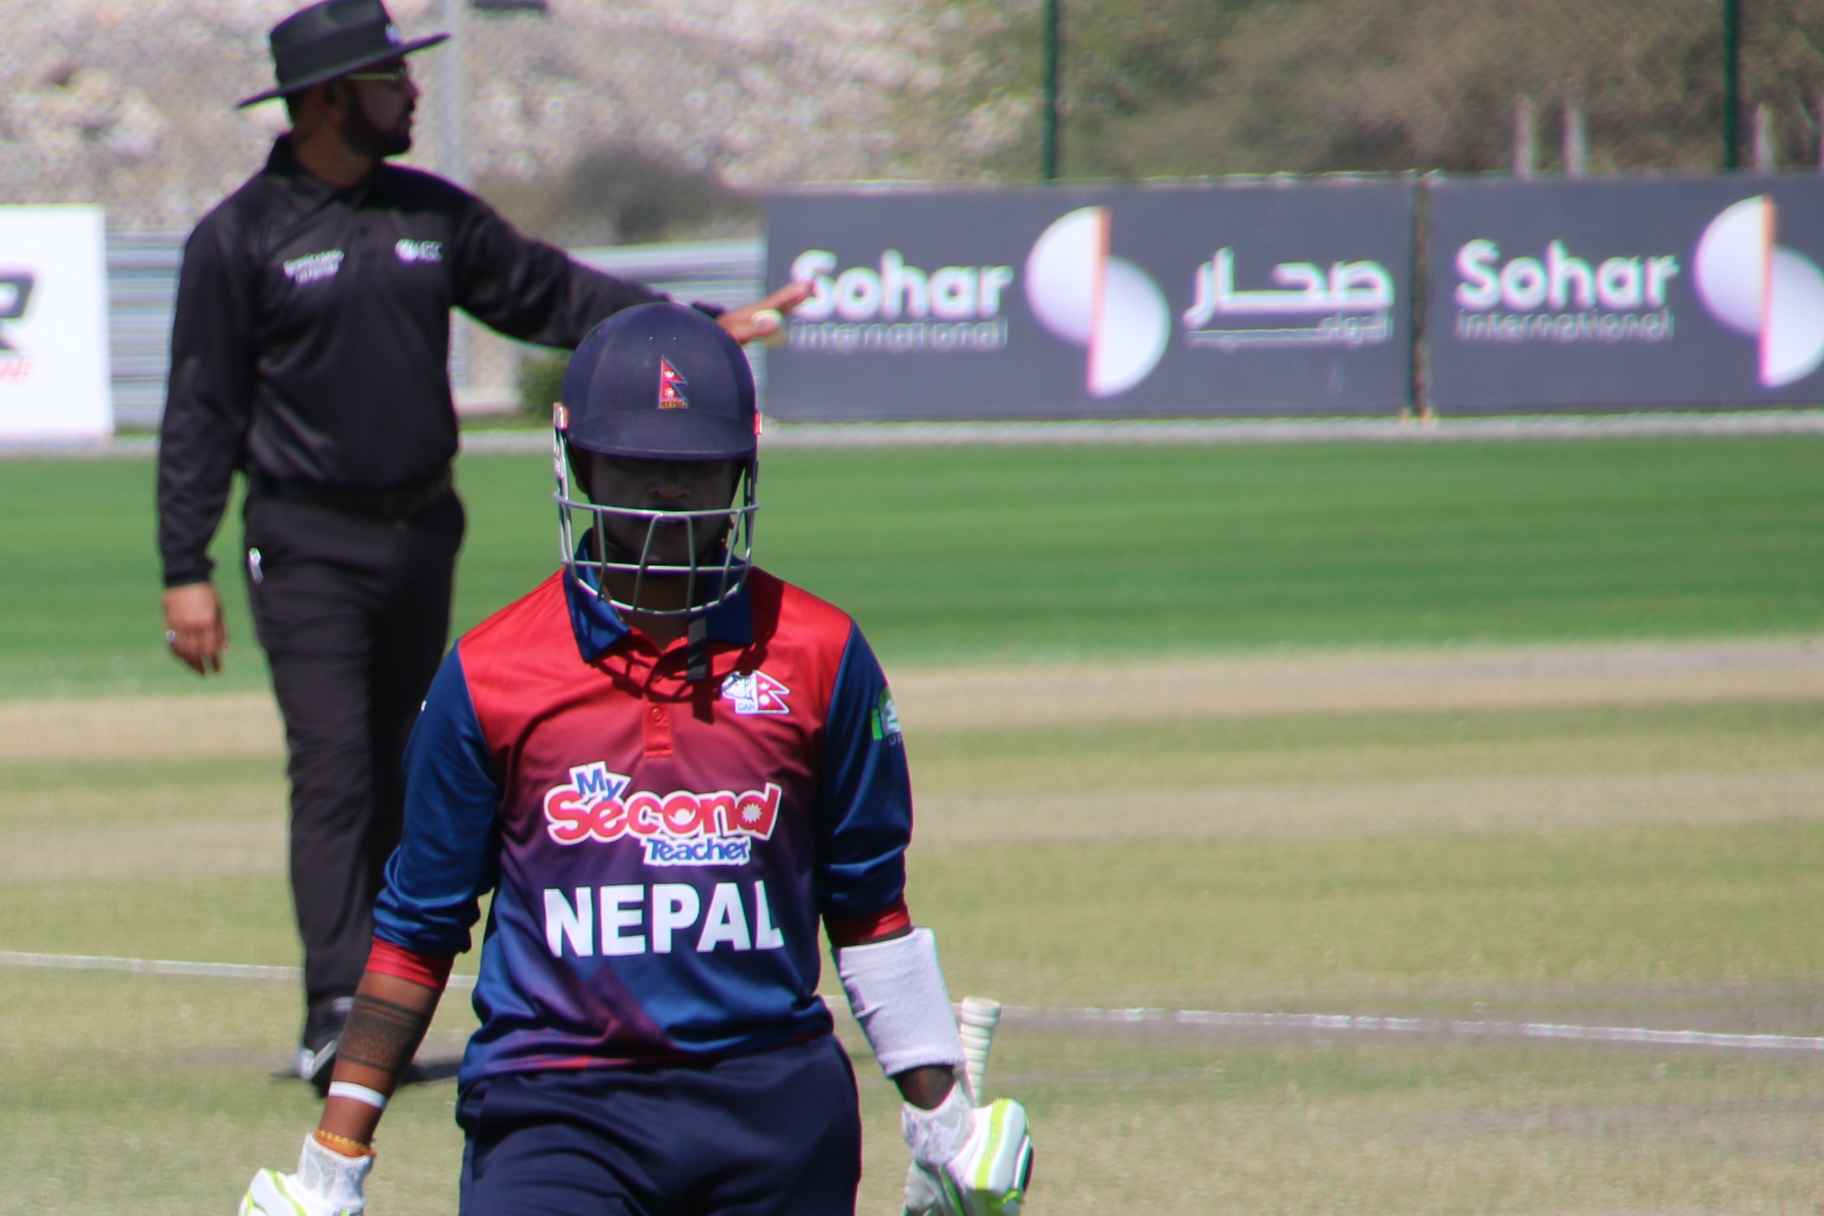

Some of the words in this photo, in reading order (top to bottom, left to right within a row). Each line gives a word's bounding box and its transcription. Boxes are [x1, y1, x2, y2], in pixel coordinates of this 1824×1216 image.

[790, 248, 1015, 320] Sohar
[1456, 238, 1680, 310] Sohar
[546, 784, 780, 842] Second
[575, 766, 625, 801] My
[645, 836, 751, 862] Teacher
[543, 880, 785, 957] NEPAL
